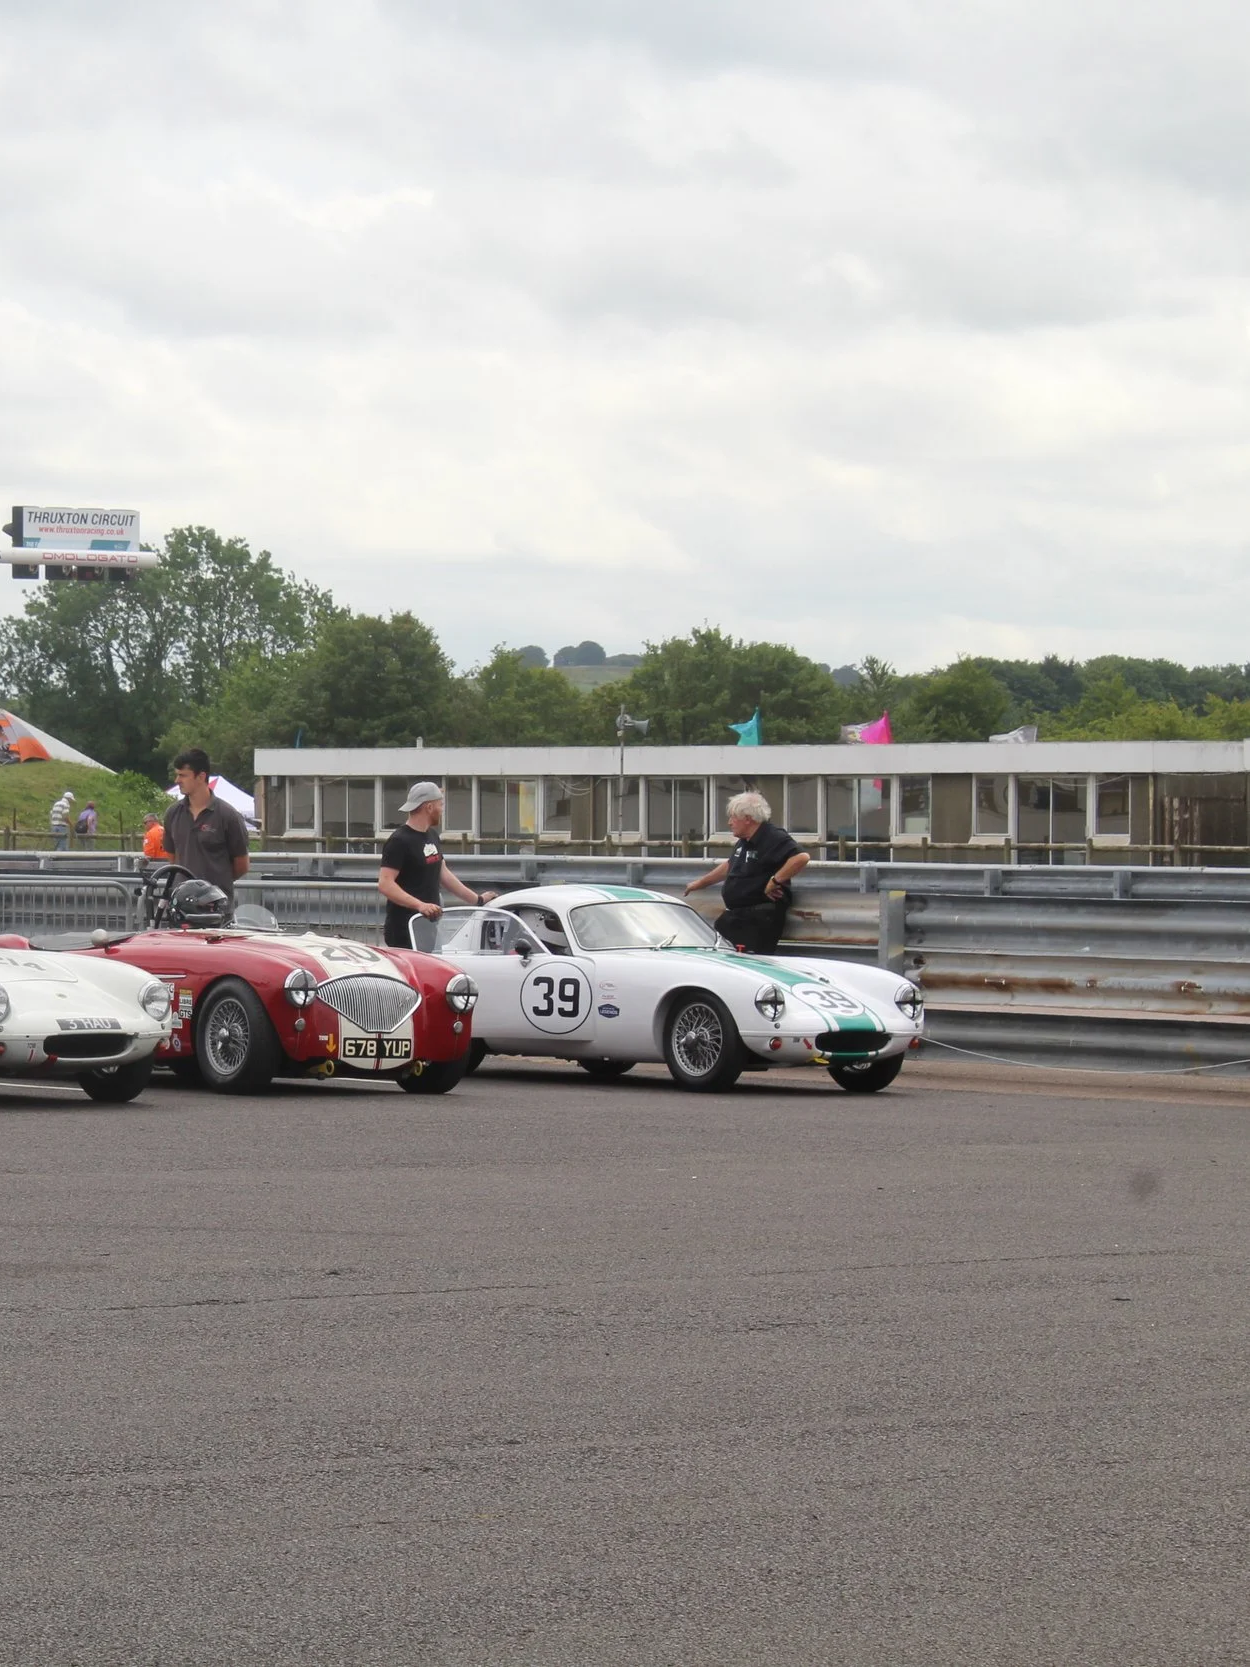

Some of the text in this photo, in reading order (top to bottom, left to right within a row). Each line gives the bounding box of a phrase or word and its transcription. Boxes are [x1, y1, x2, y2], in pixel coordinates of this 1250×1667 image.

[28, 511, 136, 527] THRUXTON CIRCUIT
[38, 526, 125, 536] www.thruxtonracing.co.uk
[42, 552, 138, 563] OMOLOGATO
[532, 976, 581, 1018] 39
[802, 990, 858, 1009] 39
[179, 1010, 192, 1018] GTS
[70, 1018, 111, 1029] 3 HAU
[345, 1040, 410, 1057] 678 YUP
